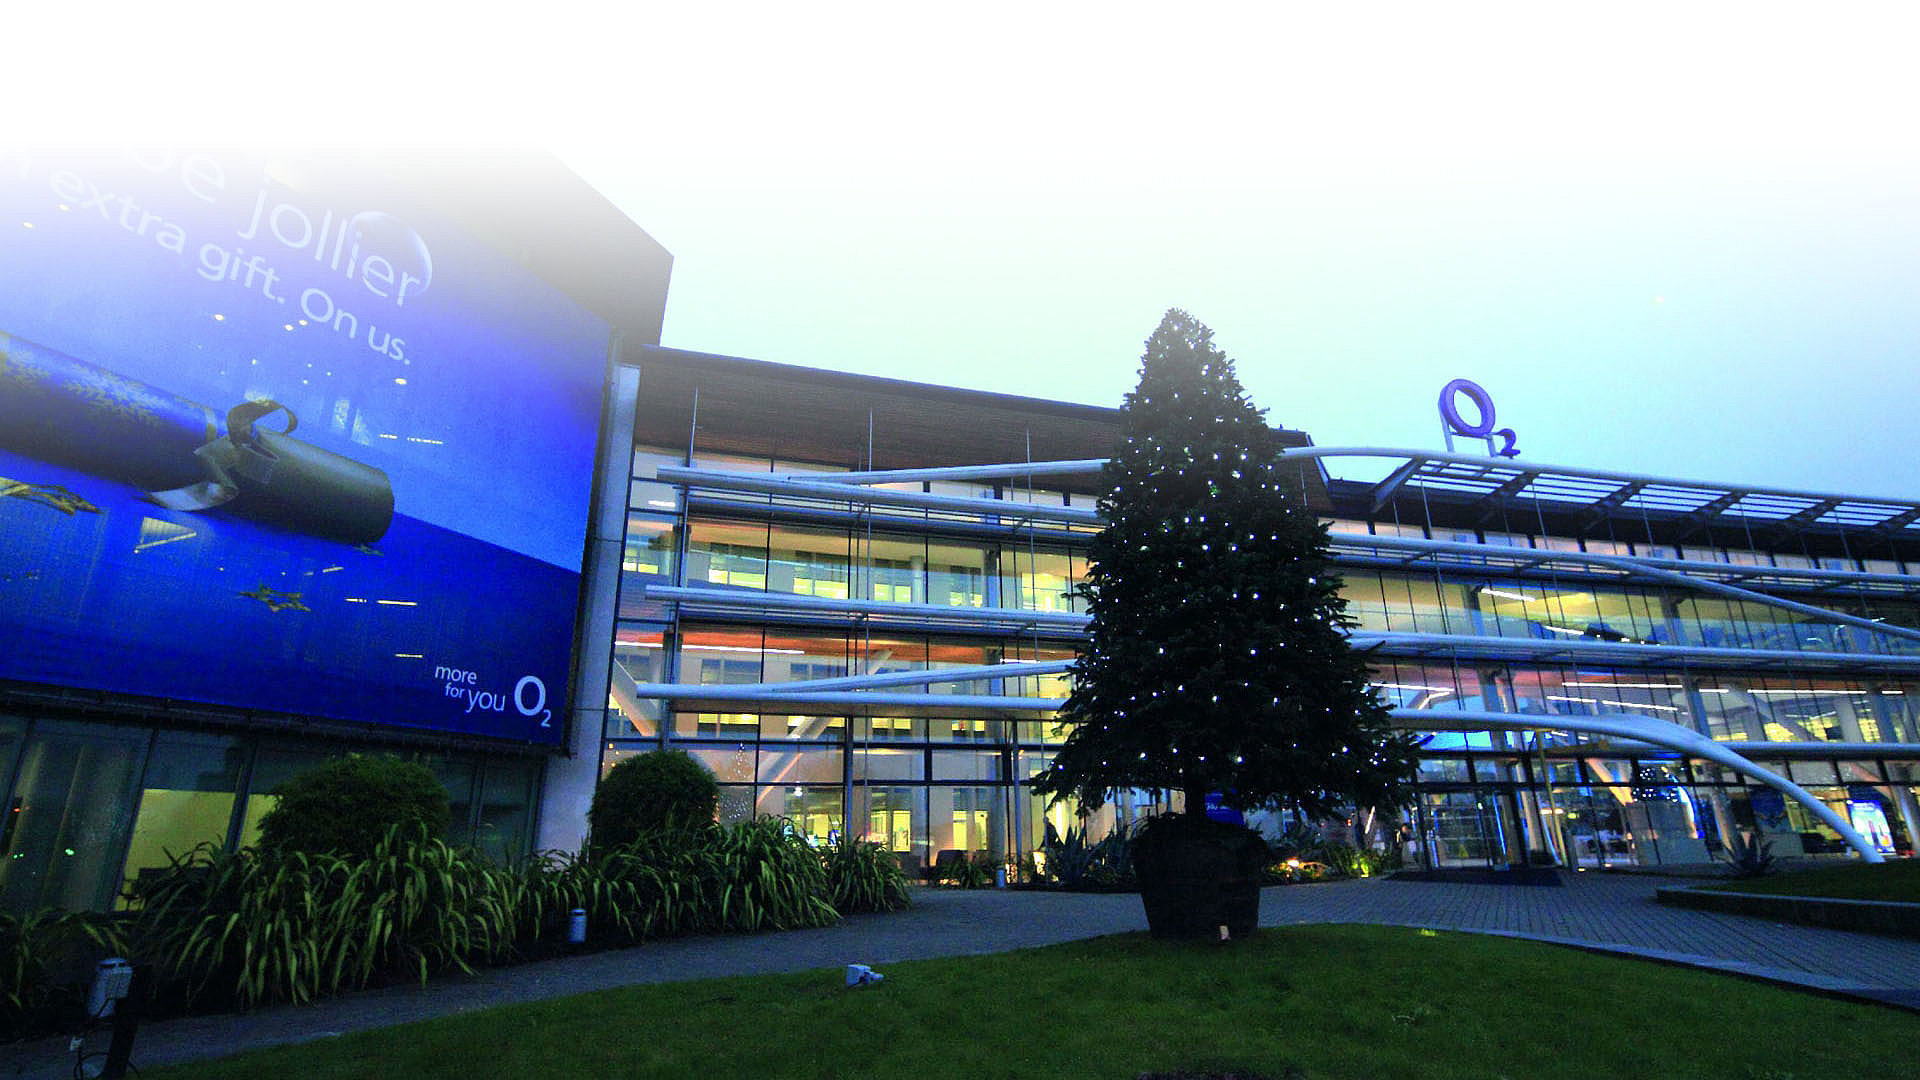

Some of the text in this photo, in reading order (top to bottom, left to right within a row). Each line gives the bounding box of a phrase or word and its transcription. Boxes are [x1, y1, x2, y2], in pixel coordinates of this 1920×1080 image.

[237, 174, 420, 306] jollier
[50, 169, 411, 365] extra gift. On us.
[434, 665, 478, 685] more
[444, 682, 506, 713] for you
[513, 675, 552, 727] O2
